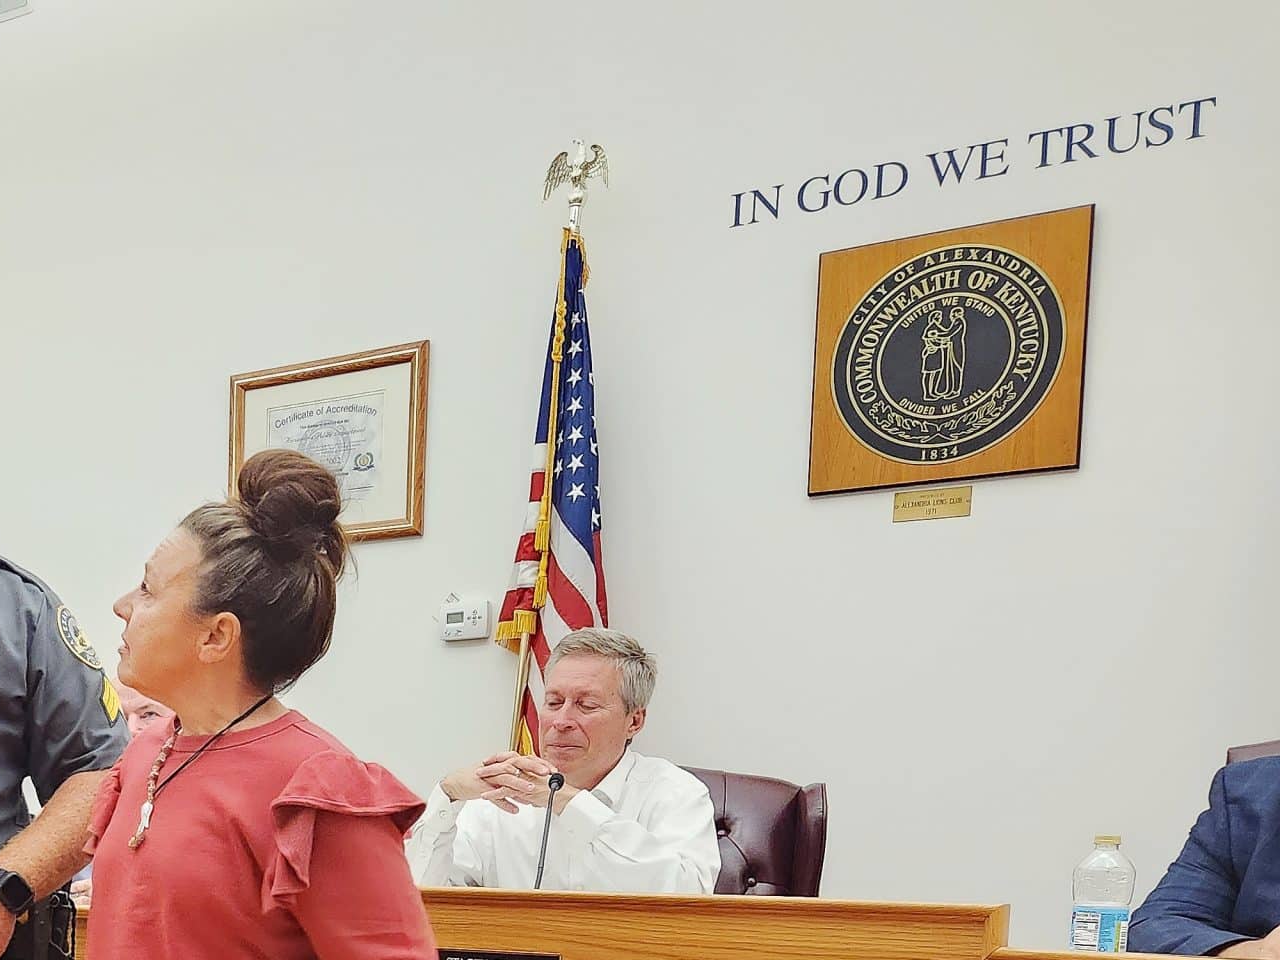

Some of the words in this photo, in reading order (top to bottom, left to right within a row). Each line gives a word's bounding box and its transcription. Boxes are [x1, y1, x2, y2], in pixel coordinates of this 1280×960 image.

[729, 184, 784, 228] IN
[797, 161, 908, 213] GOD
[926, 138, 1010, 187] WE
[1027, 97, 1217, 169] TRUST
[853, 286, 888, 326] CITY
[894, 264, 915, 283] OF
[924, 249, 1048, 297] ALEXANDRIA
[901, 302, 935, 329] UNITED
[942, 297, 959, 307] WE
[965, 298, 996, 318] STAND
[855, 269, 961, 404] COMMONWEALTH
[967, 270, 999, 292] OF
[994, 281, 1040, 382] KENTUCKY
[275, 410, 314, 429] Certificate
[316, 406, 324, 416] of
[326, 403, 377, 417] Accreditation
[899, 397, 935, 415] DIVIDED
[942, 404, 958, 414] WE
[963, 389, 987, 407] FALL
[921, 446, 959, 461] 1834
